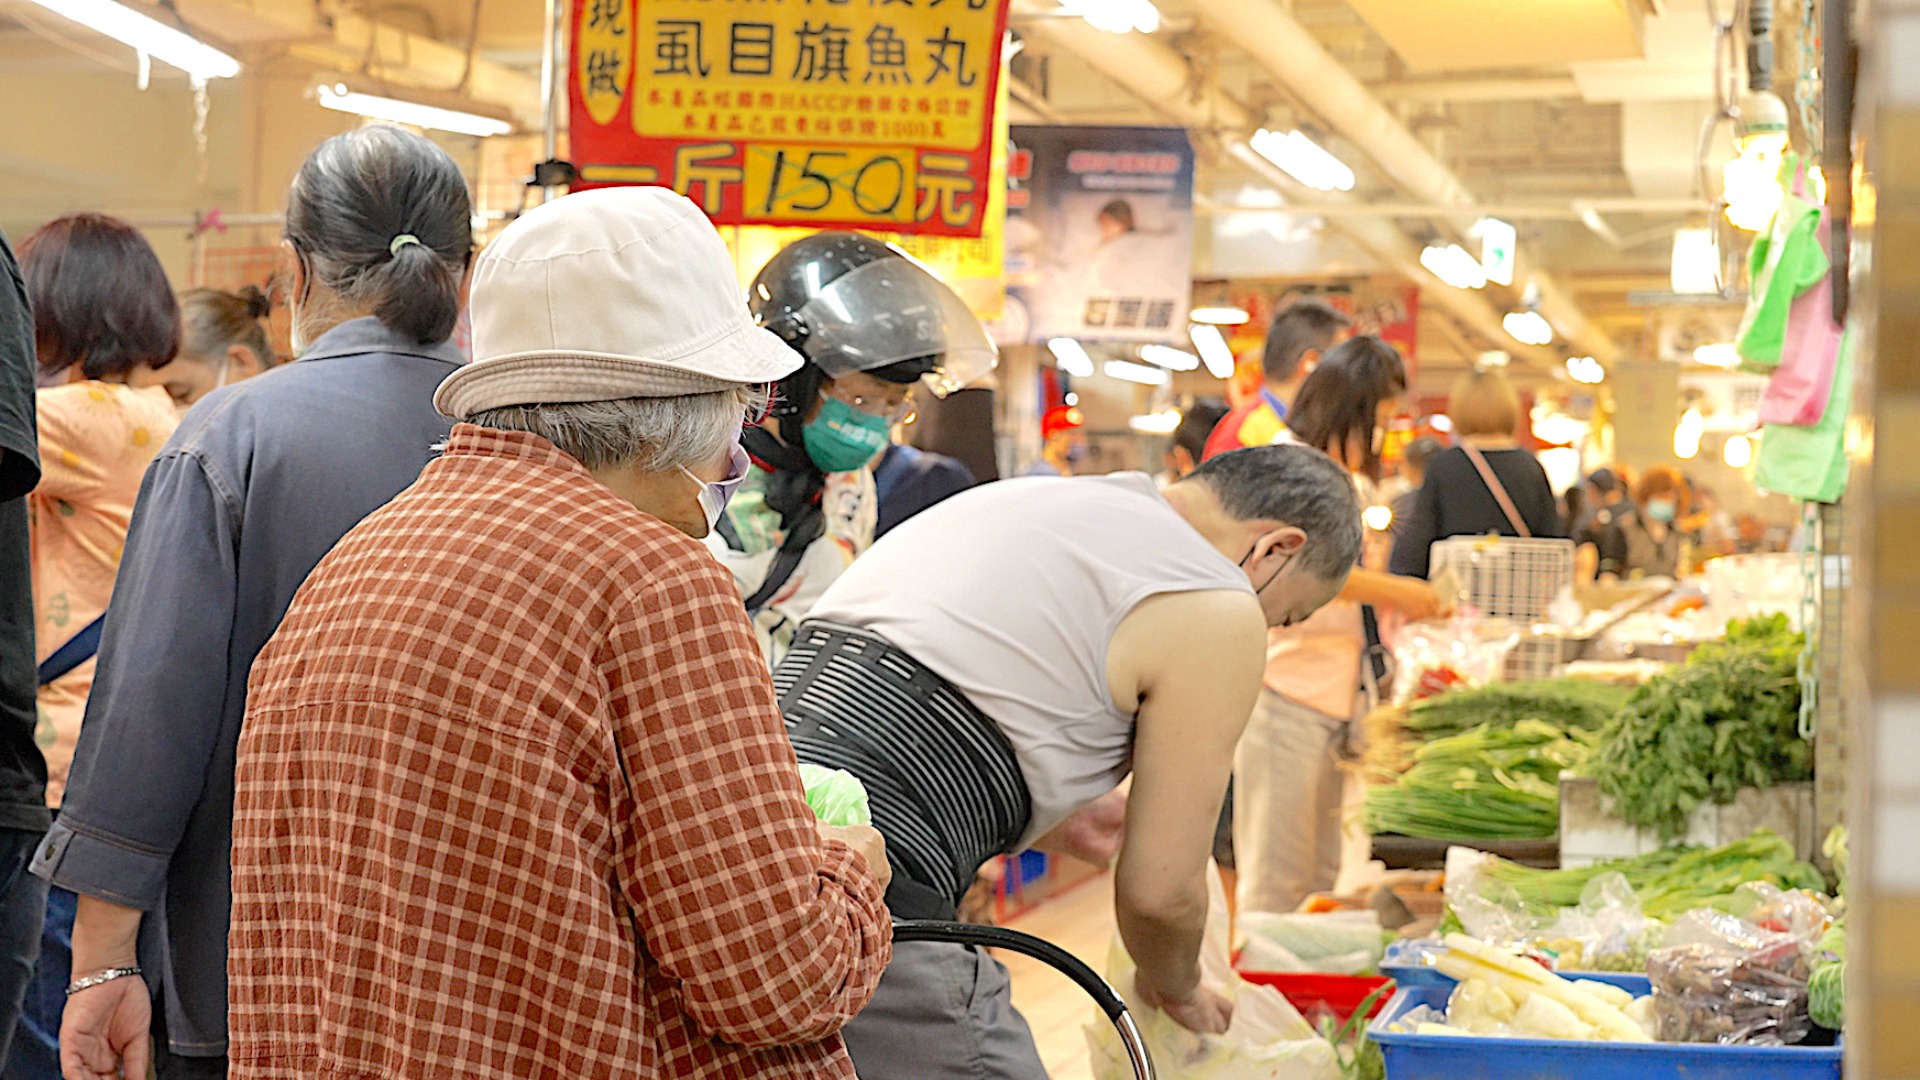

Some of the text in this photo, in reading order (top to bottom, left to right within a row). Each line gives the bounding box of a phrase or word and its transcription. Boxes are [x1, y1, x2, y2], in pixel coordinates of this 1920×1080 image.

[653, 19, 977, 88] 虱目旗魚丸
